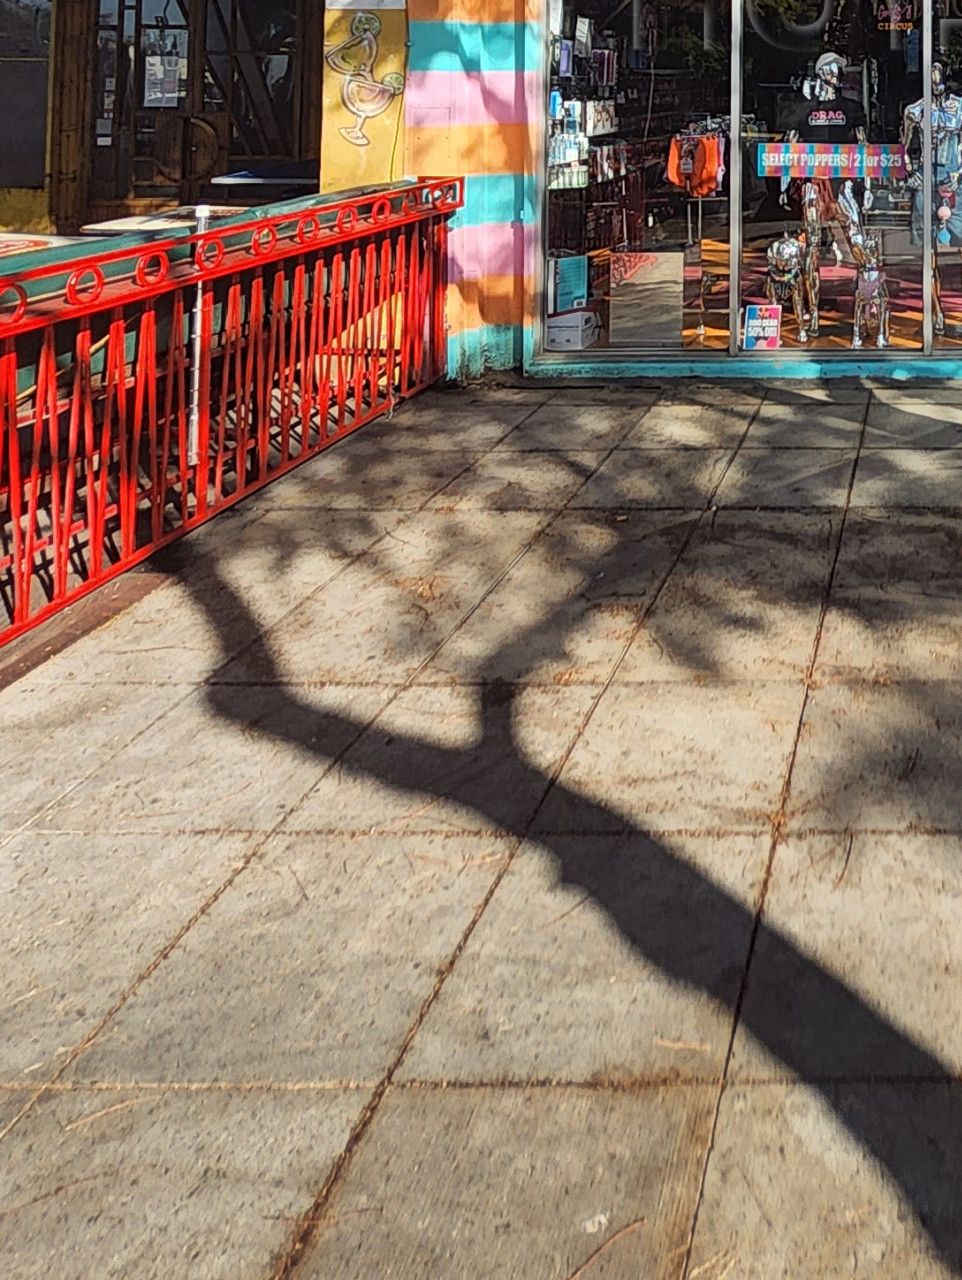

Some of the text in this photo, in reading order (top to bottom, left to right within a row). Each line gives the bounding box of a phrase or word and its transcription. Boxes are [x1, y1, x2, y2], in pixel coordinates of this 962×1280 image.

[811, 110, 843, 120] DRAG
[762, 153, 798, 166] SELECT
[801, 153, 848, 166] POPPERS
[854, 154, 861, 166] 2
[880, 154, 902, 167] $25
